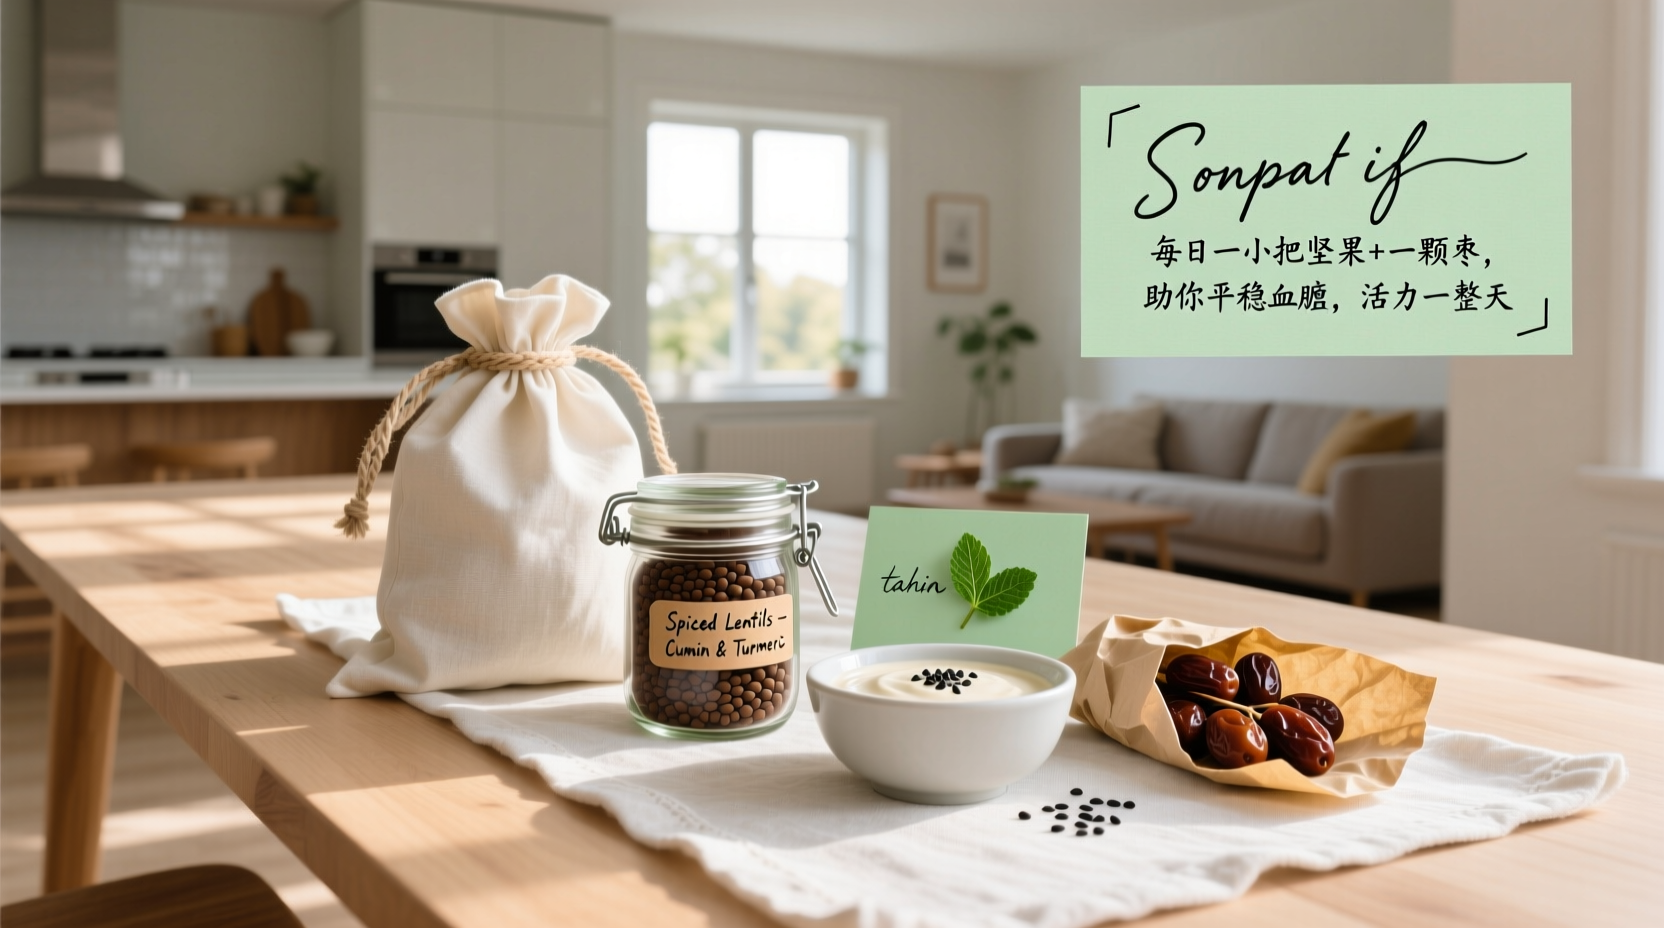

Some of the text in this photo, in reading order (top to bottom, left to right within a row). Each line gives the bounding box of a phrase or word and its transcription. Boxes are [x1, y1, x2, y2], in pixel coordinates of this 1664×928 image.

[1133, 121, 1351, 223] Sonpat
[881, 565, 947, 594] tahin
[665, 610, 718, 637] Spiced
[725, 607, 773, 631] Lentils
[665, 638, 710, 658] Cumin
[715, 639, 727, 658] &
